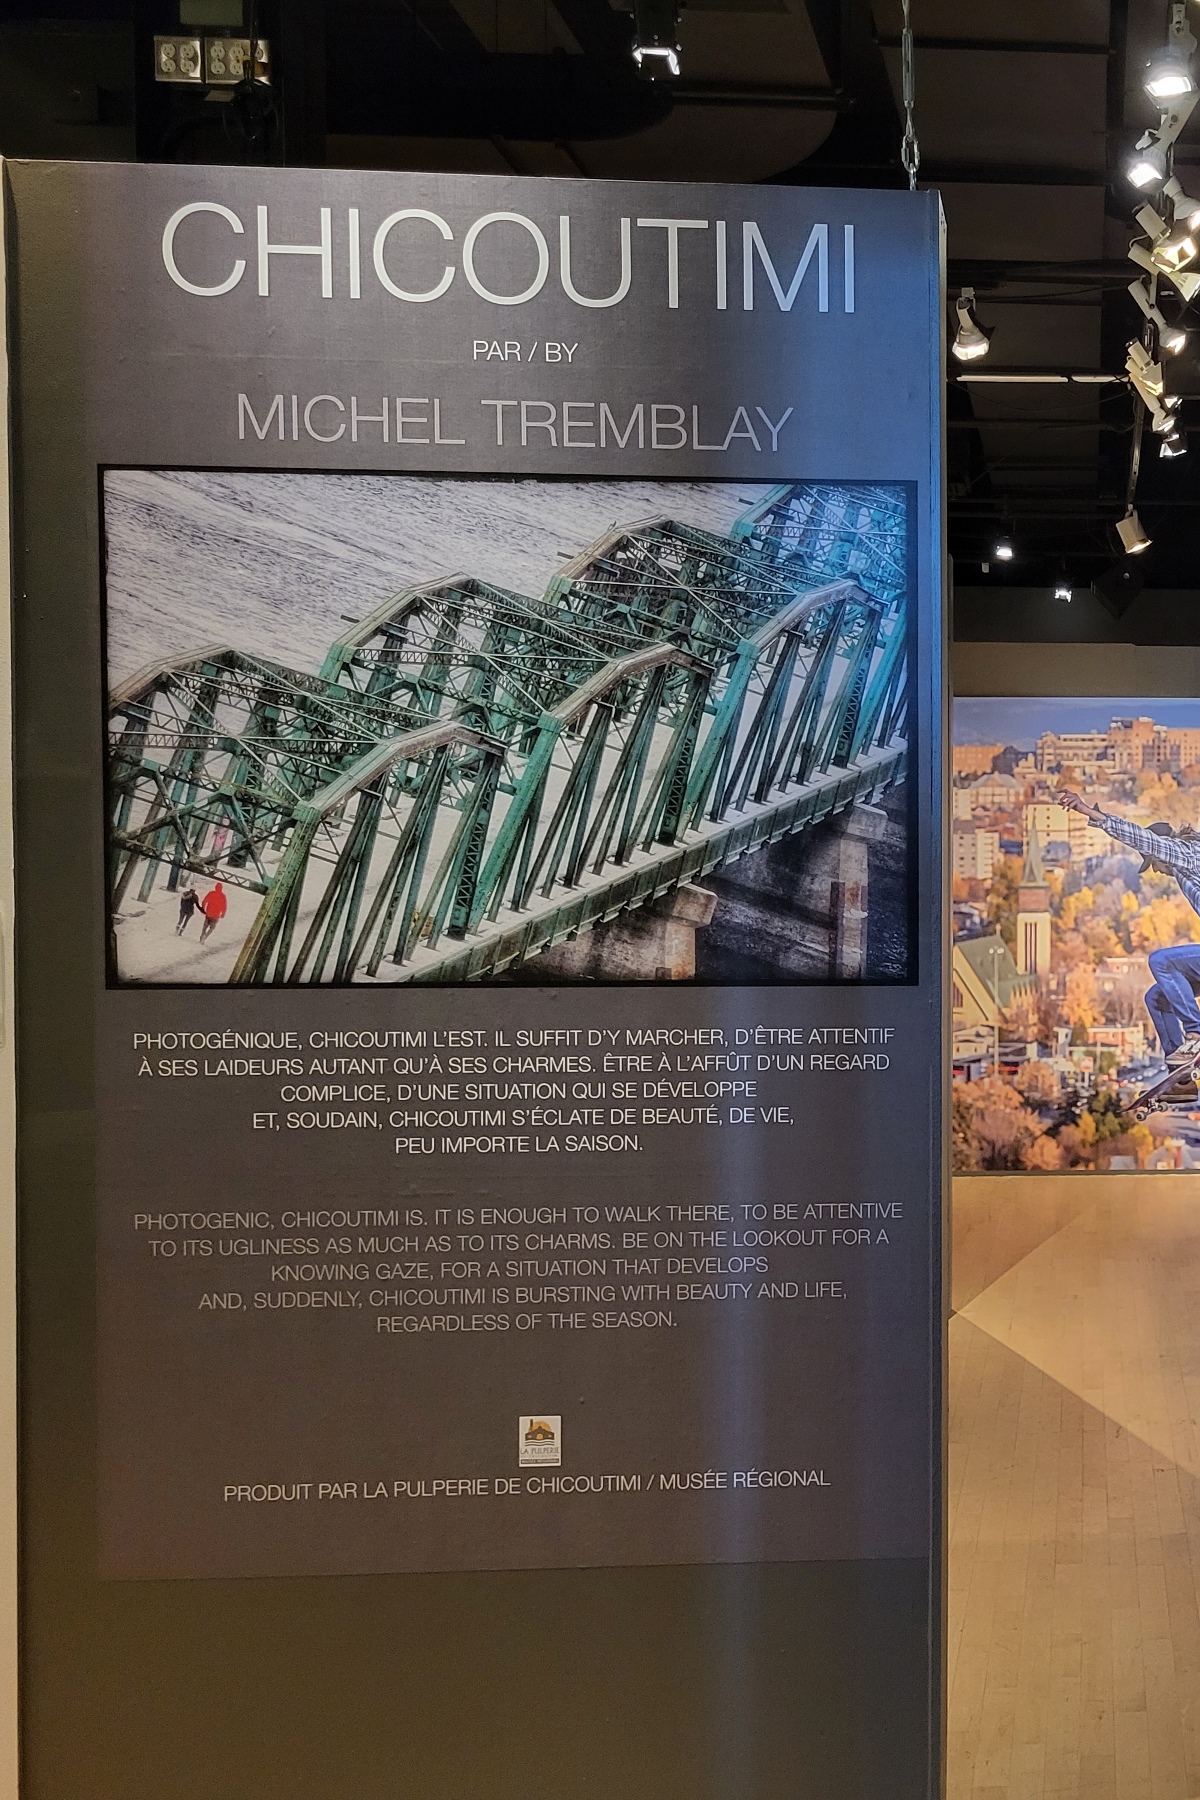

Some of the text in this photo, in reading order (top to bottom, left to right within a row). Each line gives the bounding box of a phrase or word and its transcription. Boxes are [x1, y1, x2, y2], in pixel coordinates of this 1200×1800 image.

[161, 200, 857, 315] CHICOUTIMI
[473, 340, 579, 363] PAR / BY
[238, 392, 794, 453] MICHEL TREMBLAY
[133, 1028, 303, 1052] PHOTOGÉNIQUE,
[309, 1030, 427, 1049] CHICOUTIMI
[495, 1030, 512, 1047] IL
[516, 1029, 583, 1047] SUFFIT
[626, 1028, 728, 1048] MARCHER,
[808, 1027, 895, 1045] ATTENTIF
[137, 1055, 153, 1077] À
[158, 1059, 199, 1077] SES
[204, 1058, 304, 1077] LAIDEURS
[308, 1057, 389, 1075] AUTANT
[448, 1057, 487, 1074] SES
[492, 1055, 596, 1074] CHARMES.
[603, 1052, 653, 1072] ÊTRE
[657, 1051, 672, 1072] À
[810, 1053, 890, 1071] REGARD
[280, 1084, 391, 1104] COMPLICE,
[464, 1082, 566, 1100] SITUATION
[572, 1081, 606, 1100] QUI
[611, 1082, 638, 1099] SE
[643, 1077, 758, 1099] DÉVELOPPE
[253, 1112, 280, 1132] ET,
[286, 1111, 383, 1131] SOUDAIN,
[389, 1109, 506, 1128] CHICOUTIMI
[610, 1108, 637, 1125] DE
[642, 1104, 723, 1127] BEAUTÉ,
[729, 1107, 756, 1123] DE
[760, 1106, 794, 1125] VIE,
[395, 1134, 643, 1154] PEU IMPORTE LA SAISON.
[134, 1202, 903, 1232] PHOTOGENIC, CHICOUTIMI IS. IT IS ENOUGH TO WALK THERE, TO BE ATTENTIVE
[148, 1228, 890, 1257] TO ITS UGLINESS AS MUCH AS TO ITS CHARMS. BE ON THE LOOKOUT FOR A
[271, 1255, 769, 1282] KNOWING GAZE, FOR A SITUATION THAT DEVELOPS
[198, 1281, 847, 1312] AND, SUDDENLY, CHICOUTIMI IS BURSTING WITH BEAUTY AND LIFE,
[377, 1310, 677, 1333] REGARDLESS OF THE SEASON.
[224, 1465, 831, 1503] PRODUIT PAR LA PULPERIE DE CHICOUTIMI / MUSÉE RÉGIONAL
